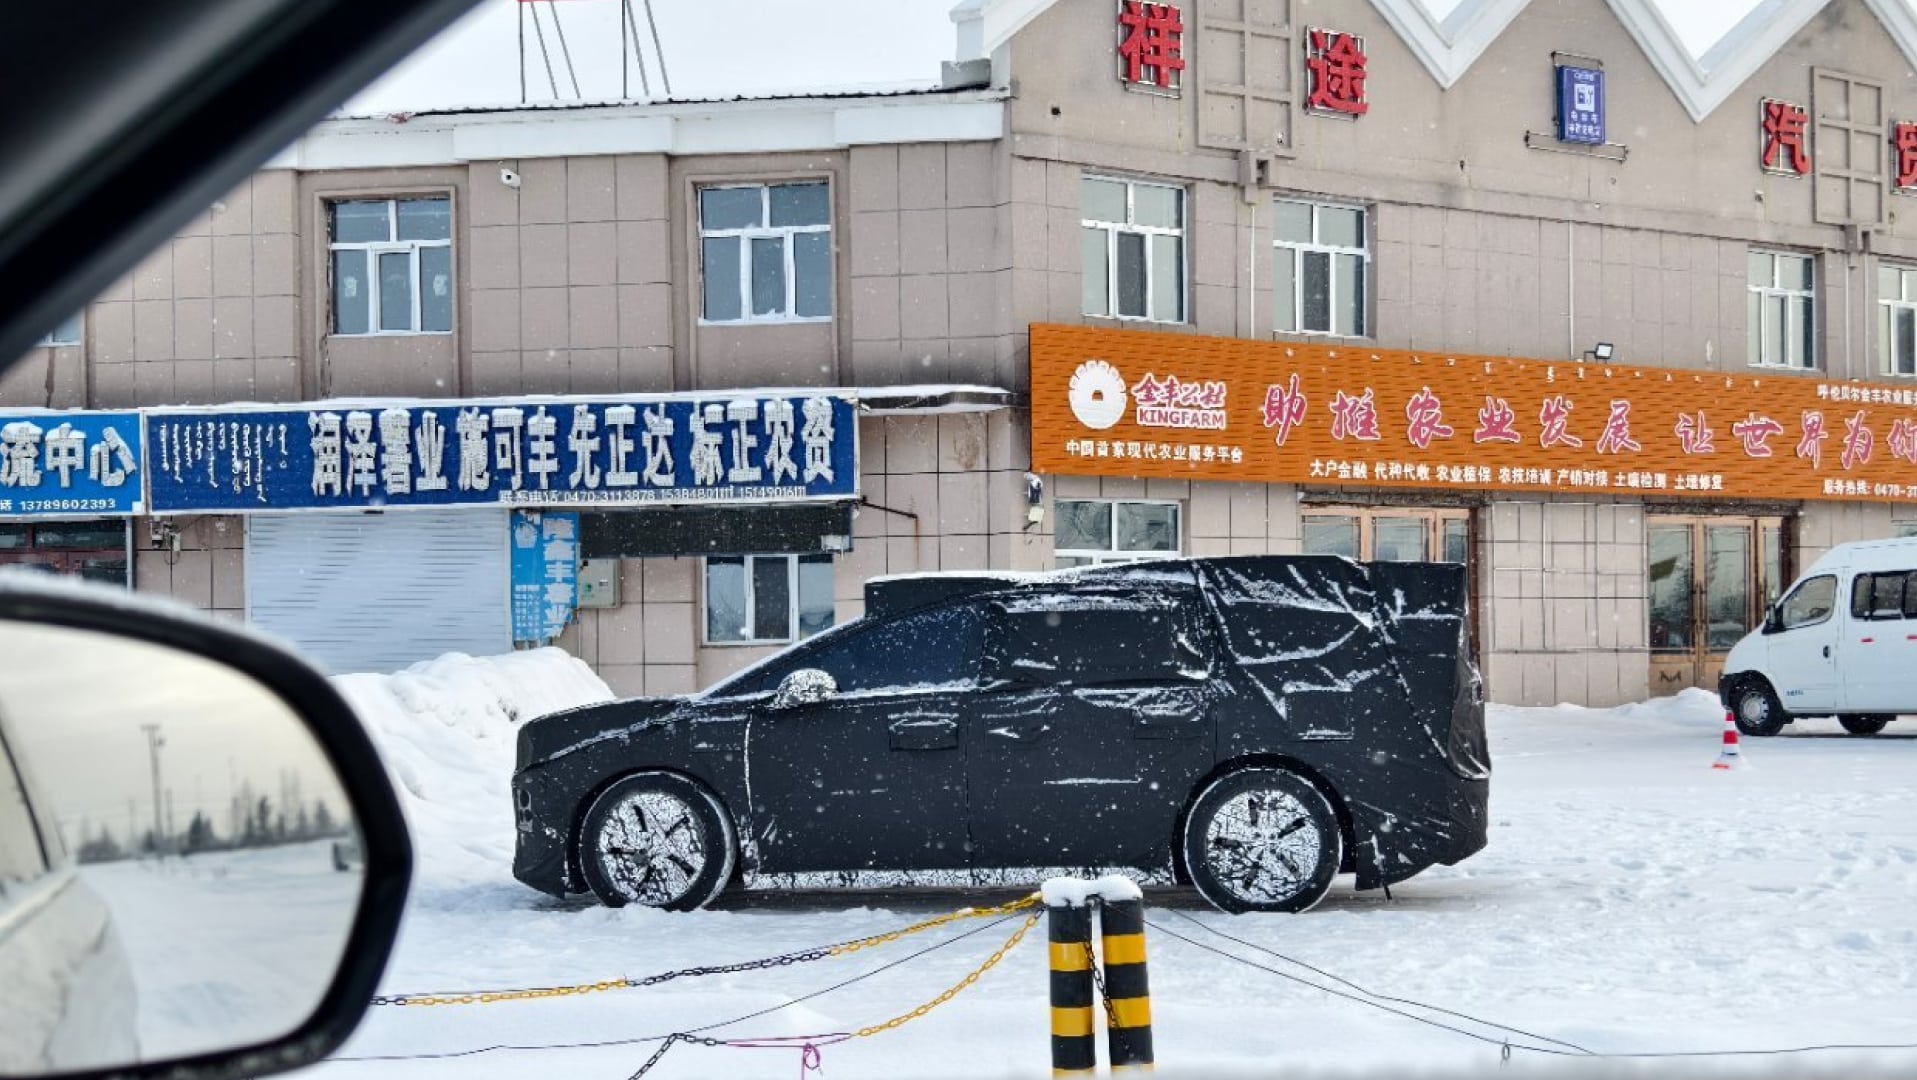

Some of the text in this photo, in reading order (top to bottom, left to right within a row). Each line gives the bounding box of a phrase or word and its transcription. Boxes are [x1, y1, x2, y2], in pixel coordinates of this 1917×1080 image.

[1131, 372, 1227, 408] 金丰公社
[1816, 384, 1917, 405] 呼伦贝尔金丰农业服
[1137, 406, 1227, 430] KINGFARM
[0, 421, 137, 488] 流中心
[308, 408, 447, 496] 润泽薯业
[457, 406, 558, 490] 施可丰
[569, 403, 675, 489] 先正达
[690, 397, 834, 485] 标正农资
[1066, 439, 1242, 464] 中国首家现代农业服务平台
[1310, 459, 1367, 479] 大户金融
[20, 498, 116, 512] 13789602393
